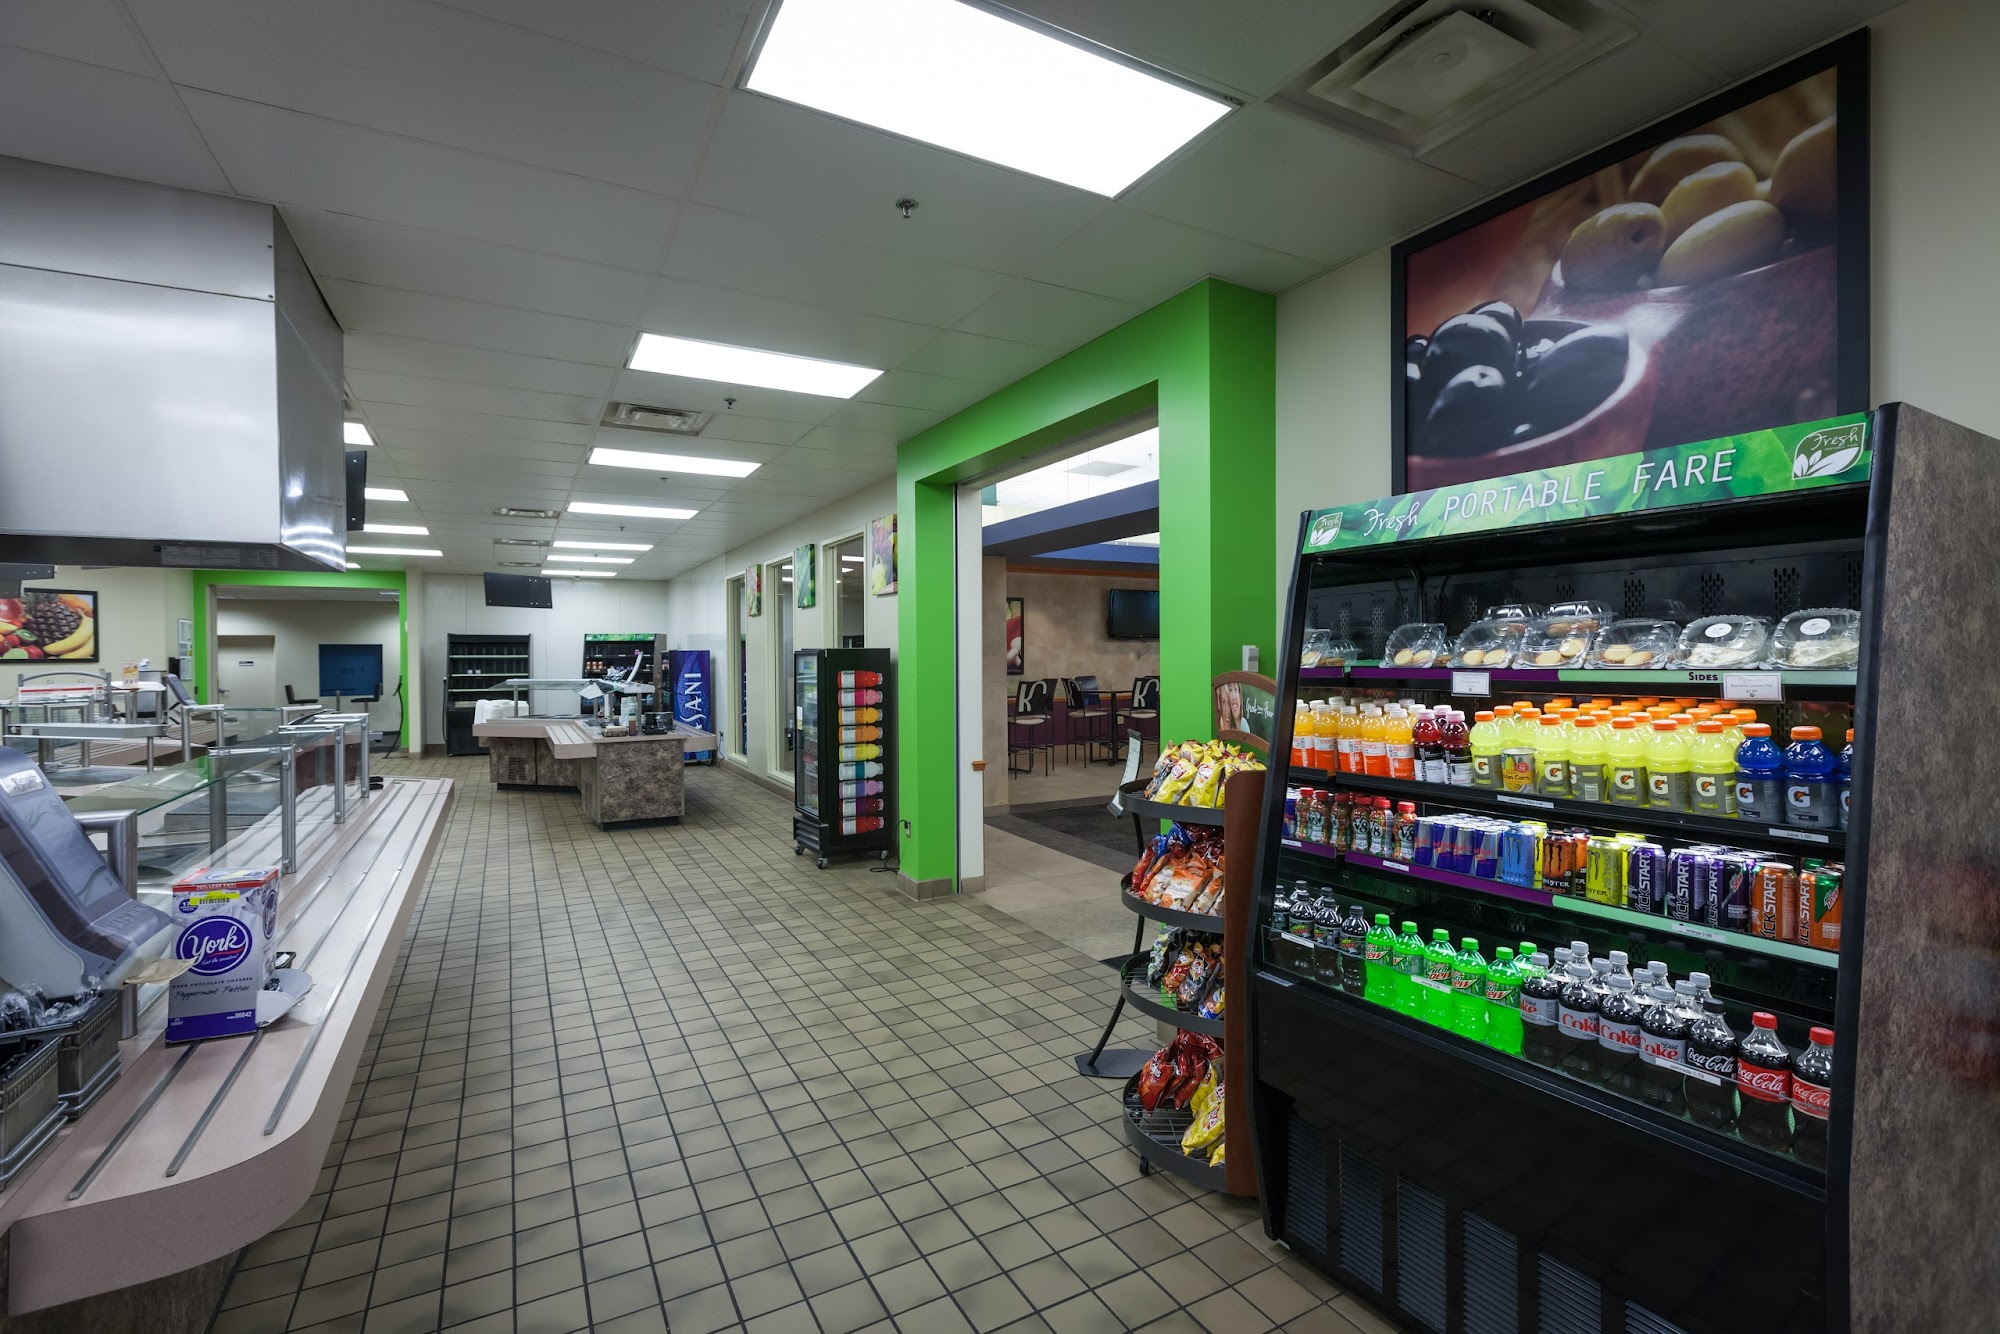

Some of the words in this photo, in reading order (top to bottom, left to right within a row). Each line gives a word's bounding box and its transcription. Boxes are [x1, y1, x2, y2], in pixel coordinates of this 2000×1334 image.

[1809, 426, 1859, 451] Fresh
[1363, 502, 1419, 537] Fresh
[1443, 470, 1605, 521] PORTABLE
[1632, 448, 1737, 494] FARE
[1688, 671, 1718, 681] SIDES
[680, 672, 707, 729] SANI
[1475, 757, 1490, 774] G
[1545, 763, 1563, 781] G
[1615, 770, 1635, 789] G
[1650, 775, 1669, 794] G
[1696, 777, 1717, 797] G
[1736, 782, 1754, 803] G
[1788, 786, 1811, 807] G
[1354, 817, 1369, 832] V8
[1400, 823, 1415, 839] V8
[1543, 878, 1570, 887] NSTER
[187, 925, 246, 966] York
[175, 988, 219, 1001] Peppermint
[222, 985, 250, 994] Patties
[1521, 999, 1537, 1014] ke
[1562, 1013, 1600, 1033] Coke
[1601, 1024, 1640, 1046] Coke
[1661, 1042, 1679, 1050] Diet
[1687, 1047, 1736, 1074] Coca-Cola
[1737, 1062, 1786, 1092] Coca-Cola
